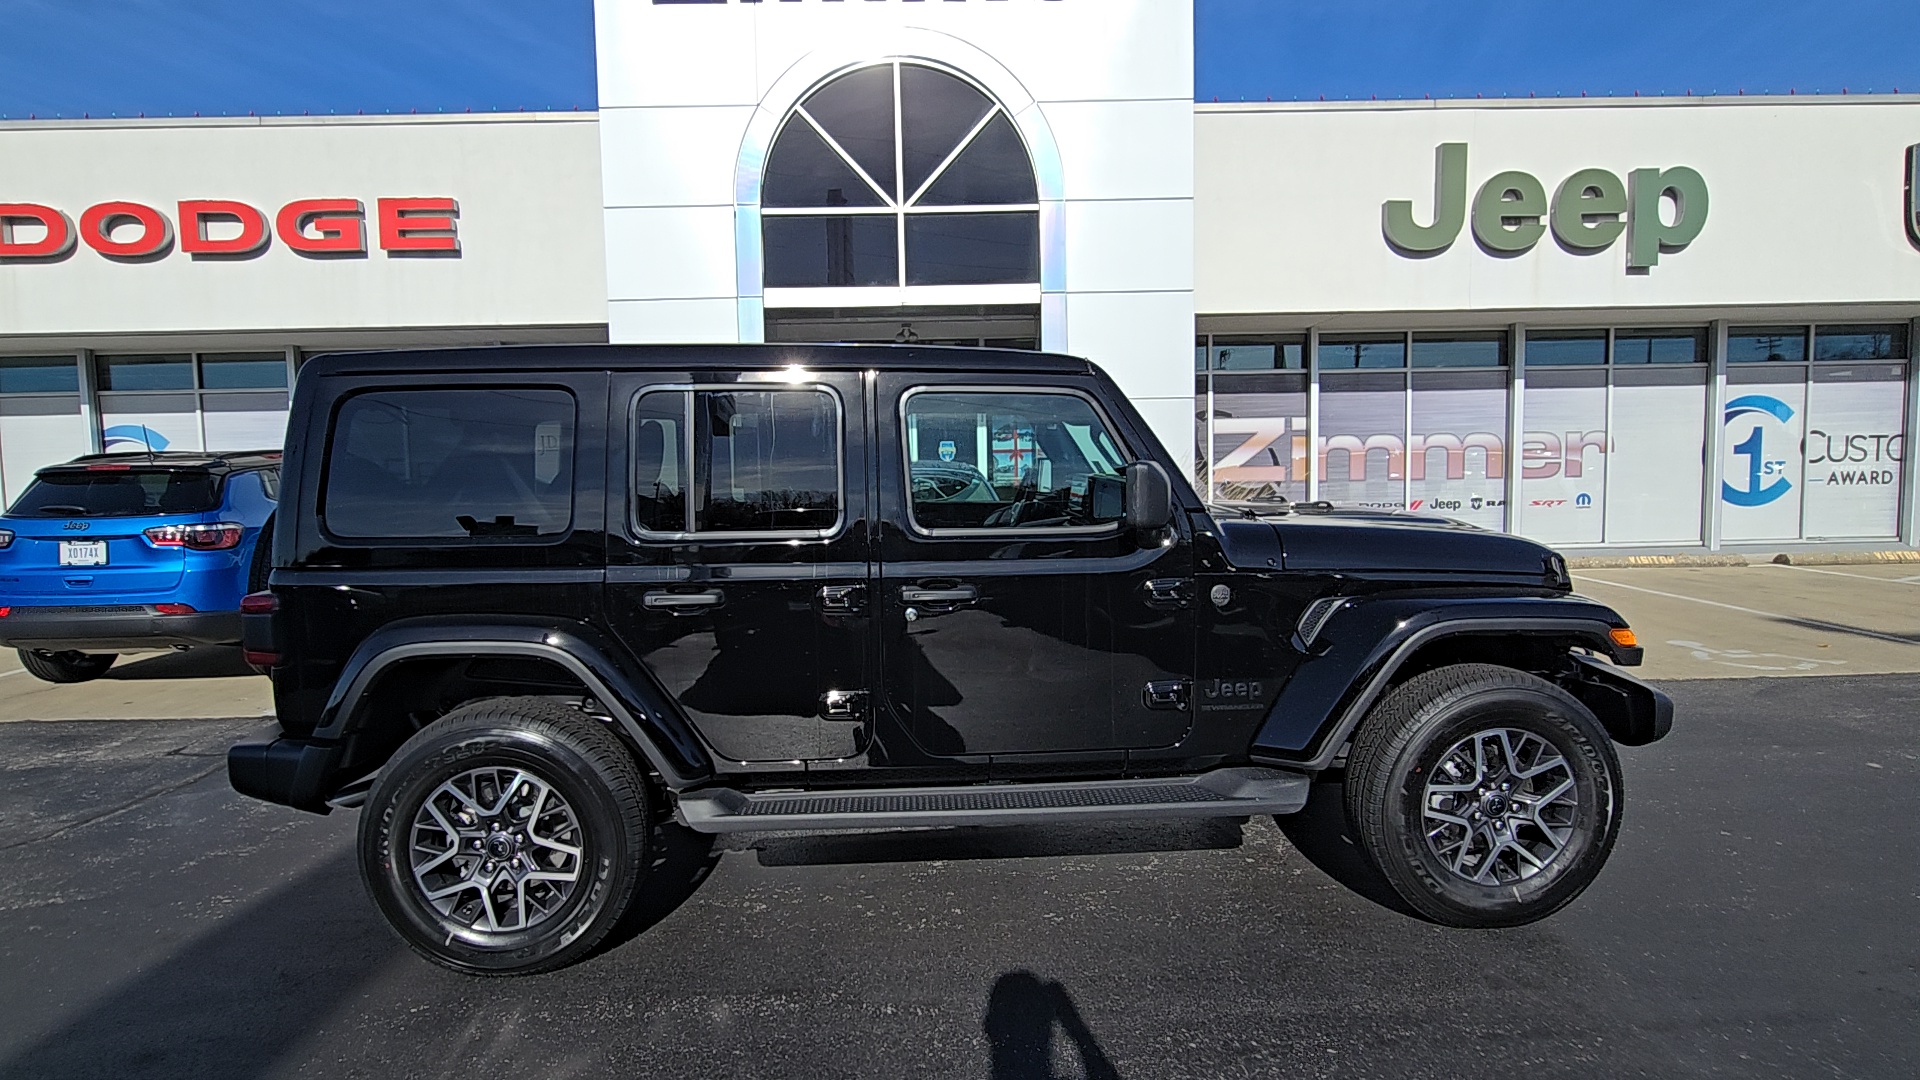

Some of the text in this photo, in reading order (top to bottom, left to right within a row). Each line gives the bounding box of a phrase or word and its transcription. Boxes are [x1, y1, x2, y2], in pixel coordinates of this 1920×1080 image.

[1382, 142, 1709, 275] Jeep
[0, 197, 461, 261] DODGE
[1212, 417, 1615, 483] Zimmer
[1800, 430, 1905, 464] CUSTO
[1826, 470, 1894, 486] AWARD
[1429, 498, 1461, 511] Jeep
[1529, 499, 1567, 508] SRT
[63, 520, 91, 531] Jeep
[1204, 678, 1262, 700] Jeep
